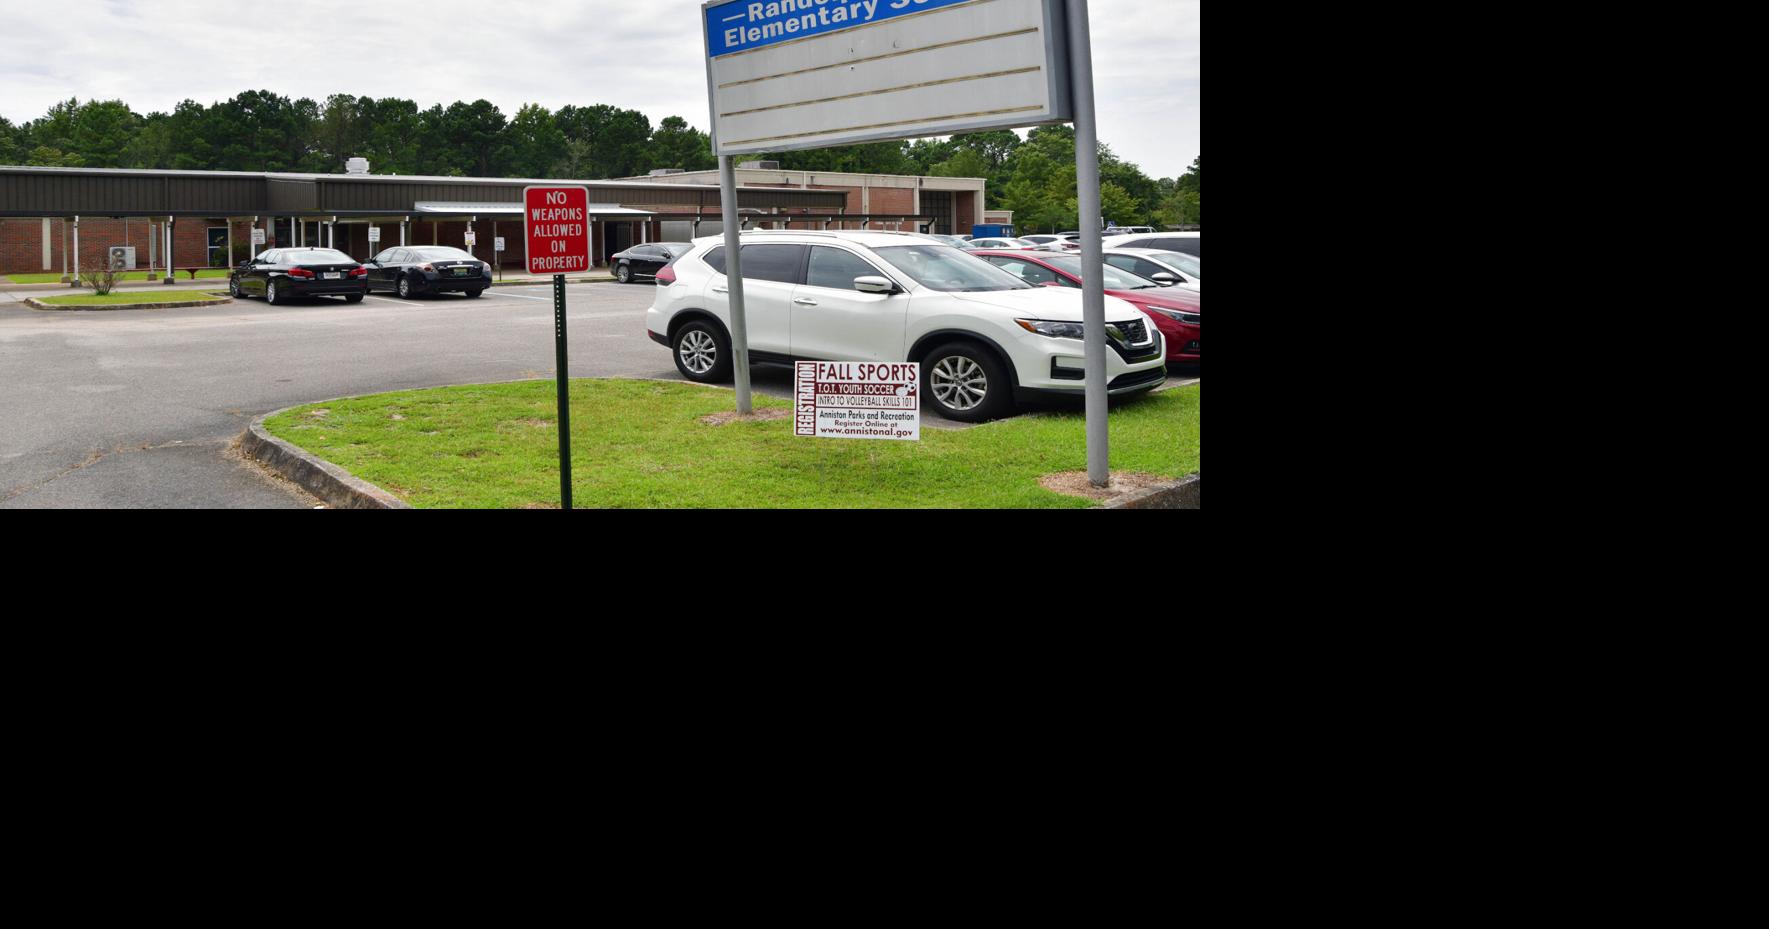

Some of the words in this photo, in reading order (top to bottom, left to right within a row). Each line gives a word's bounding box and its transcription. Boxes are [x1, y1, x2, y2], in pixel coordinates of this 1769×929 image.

[724, 0, 878, 48] Elementary
[546, 191, 567, 205] NO
[532, 207, 583, 221] WEAPONS
[533, 223, 582, 237] ALLOWED
[551, 240, 566, 253] ON
[532, 255, 585, 270] PROPERTY
[818, 363, 853, 380] FALL
[858, 364, 916, 381] SPORTS
[839, 384, 862, 394] YOUTH
[864, 384, 894, 395] SOCCER
[797, 363, 816, 433] REGISTRATION
[817, 395, 835, 405] INTRO
[836, 396, 845, 406] TO
[846, 396, 881, 406] VOLLEYBALL
[882, 396, 900, 407] SKILLS
[902, 397, 912, 407] 101
[819, 410, 847, 419] Anniston
[848, 410, 865, 419] Parks
[866, 411, 879, 420] and
[880, 411, 915, 421] Recreation
[834, 420, 863, 428] Register
[864, 420, 889, 428] Online
[820, 427, 913, 438] www.annistonal.gov
